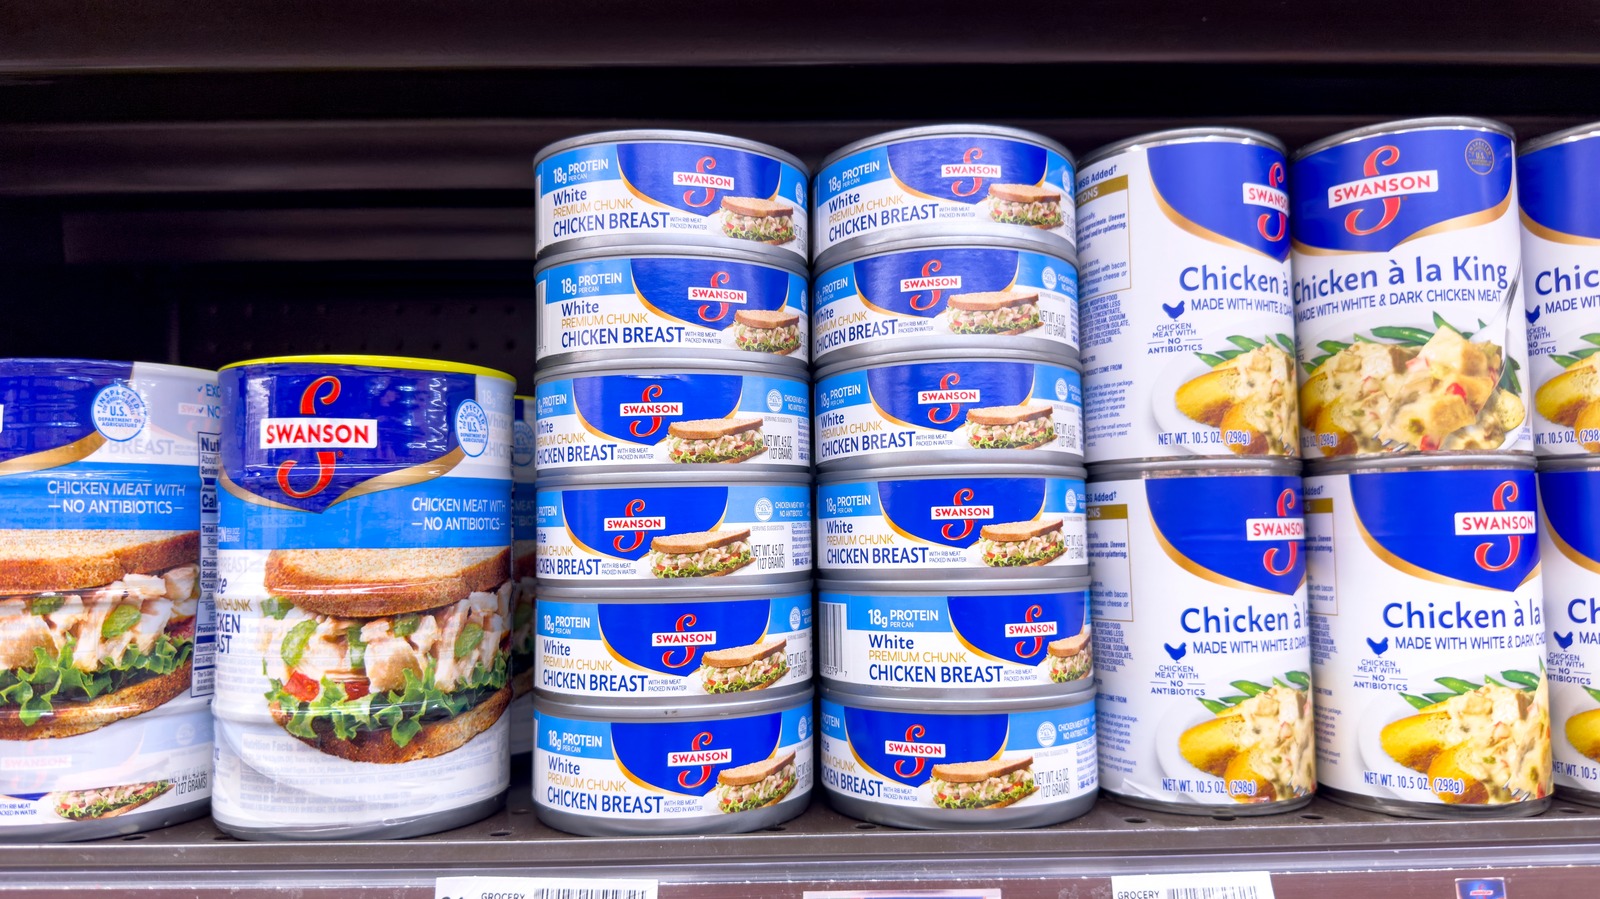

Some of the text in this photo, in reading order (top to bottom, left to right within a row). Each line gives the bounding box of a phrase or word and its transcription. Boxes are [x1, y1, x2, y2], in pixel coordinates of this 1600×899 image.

[553, 159, 608, 184] 18g PROTEIN
[829, 161, 880, 191] 18g PROTEIN
[945, 166, 998, 175] SWANSON
[677, 174, 731, 187] SWANSON
[1334, 174, 1430, 203] SWANSON
[553, 189, 587, 206] White
[829, 192, 860, 213] White
[554, 198, 633, 218] PREMIUM CHUNK
[554, 212, 670, 237] CHICKEN BREAST
[829, 204, 939, 242] CHICKEN BREAST
[904, 278, 957, 289] SWANSON
[1179, 264, 1278, 293] Chicken
[1293, 256, 1507, 305] Chicken à la King
[1535, 265, 1600, 296] Chic
[692, 289, 743, 300] SWANSON
[1191, 298, 1224, 311] MADE
[1226, 298, 1253, 311] WITH
[1255, 299, 1278, 312] WHITE
[1316, 302, 1339, 320] WITH
[1341, 296, 1376, 316] WHITE
[1379, 293, 1386, 306] &
[1389, 290, 1423, 305] DARK
[1426, 290, 1475, 303] CHICKEN
[1478, 289, 1501, 302] MEAT
[1546, 298, 1577, 314] MADE
[849, 319, 898, 340] BREAST
[1157, 322, 1191, 331] CHICKEN
[1174, 328, 1196, 337] WITH
[562, 327, 685, 348] CHICKEN BREAST
[1148, 344, 1202, 354] ANTIBIOTICS
[543, 394, 566, 407] PROTEIN
[922, 391, 976, 401] SWANSON
[110, 406, 127, 416] U.S.
[623, 405, 678, 414] SWANSON
[266, 425, 369, 444] SWANSON
[468, 422, 478, 432] U.S.
[821, 436, 859, 457] CHICKEN
[862, 432, 916, 451] BREAST
[1158, 431, 1250, 445] NET WT. 10.5 OZ. (298g)
[568, 444, 617, 462] BREAST
[47, 480, 186, 497] CHICKEN MEAT WITH
[63, 500, 172, 514] NO ANTIBIOTICS
[412, 497, 506, 513] CHICKEN MEAT WITH
[935, 508, 990, 517] SWANSON
[424, 517, 499, 531] NO ANTIBIOTICS
[607, 519, 661, 528] SWANSON
[1463, 516, 1534, 531] SWANSON
[827, 547, 928, 564] CHICKEN BREAST
[558, 559, 601, 575] BREAST
[868, 609, 938, 628] 18g PROTEIN
[1180, 604, 1301, 633] Chicken à
[1382, 598, 1540, 629] Chicken à la
[1009, 624, 1054, 635] SWANSON
[656, 633, 712, 643] SWANSON
[869, 634, 914, 650] White
[1395, 635, 1534, 650] MADE WITH WHITE & DARK
[1193, 641, 1226, 654] MADE
[1229, 640, 1258, 653] WITH
[1261, 639, 1288, 652] WHITE
[869, 650, 967, 663] PREMIUM CHUNK
[1361, 659, 1396, 667] CHICKEN
[1549, 652, 1579, 661] CHICKEN
[869, 664, 1003, 683] CHICKEN BREAST
[1155, 671, 1176, 679] MEAT
[1358, 665, 1378, 673] MEAT
[544, 669, 648, 691] CHICKEN BREAST
[1354, 681, 1408, 691] ANTIBIOTICS
[1547, 674, 1591, 684] NTIBIOTICS
[1151, 688, 1205, 696] ANTIBIOTICS
[549, 731, 602, 750] 18g PROTEIN
[889, 743, 941, 754] SWANSON
[672, 751, 728, 763] SWANSON
[548, 756, 580, 775] White
[1552, 759, 1597, 780] NET WT. 10.5
[841, 773, 883, 797] BREAST
[1162, 778, 1256, 795] NET WT. 10.5 OZ. (298g)
[1364, 771, 1464, 793] NET WT. 10.5 OZ. (298g)
[548, 786, 663, 813] CHICKEN BREAST
[1118, 891, 1159, 899] GROCERY
